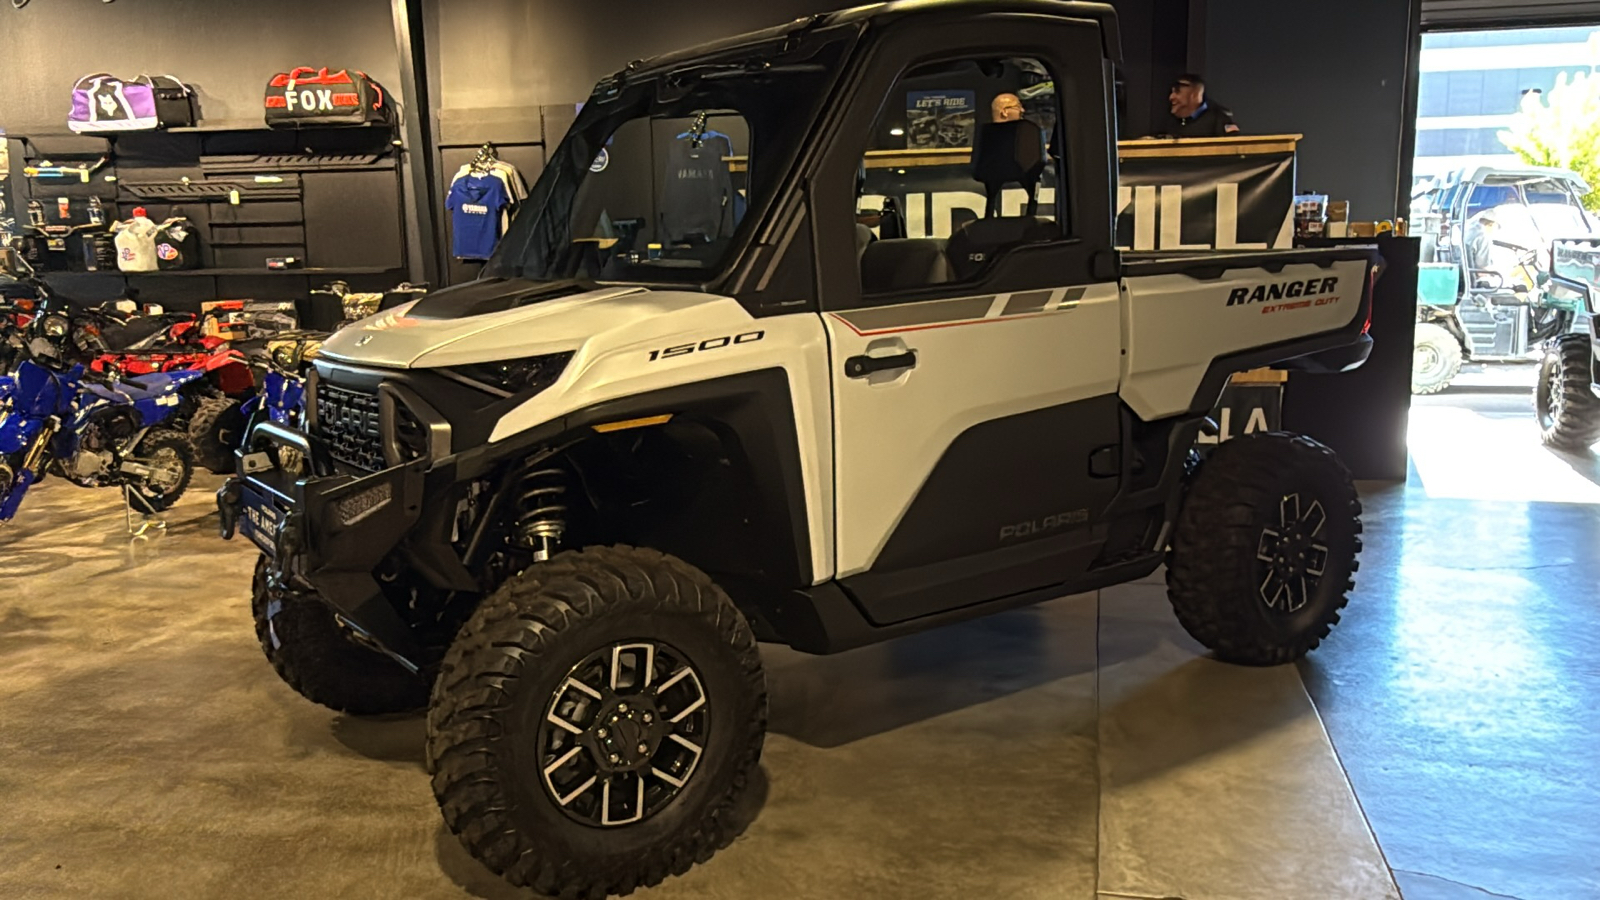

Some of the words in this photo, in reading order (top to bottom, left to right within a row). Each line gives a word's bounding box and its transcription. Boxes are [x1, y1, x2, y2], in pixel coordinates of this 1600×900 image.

[285, 89, 334, 111] FOX
[1226, 276, 1339, 307] RANGER
[1261, 300, 1311, 314] EXTREME
[1314, 296, 1340, 307] DUTY
[648, 329, 765, 362] 1500
[1000, 508, 1089, 541] POLARIS
